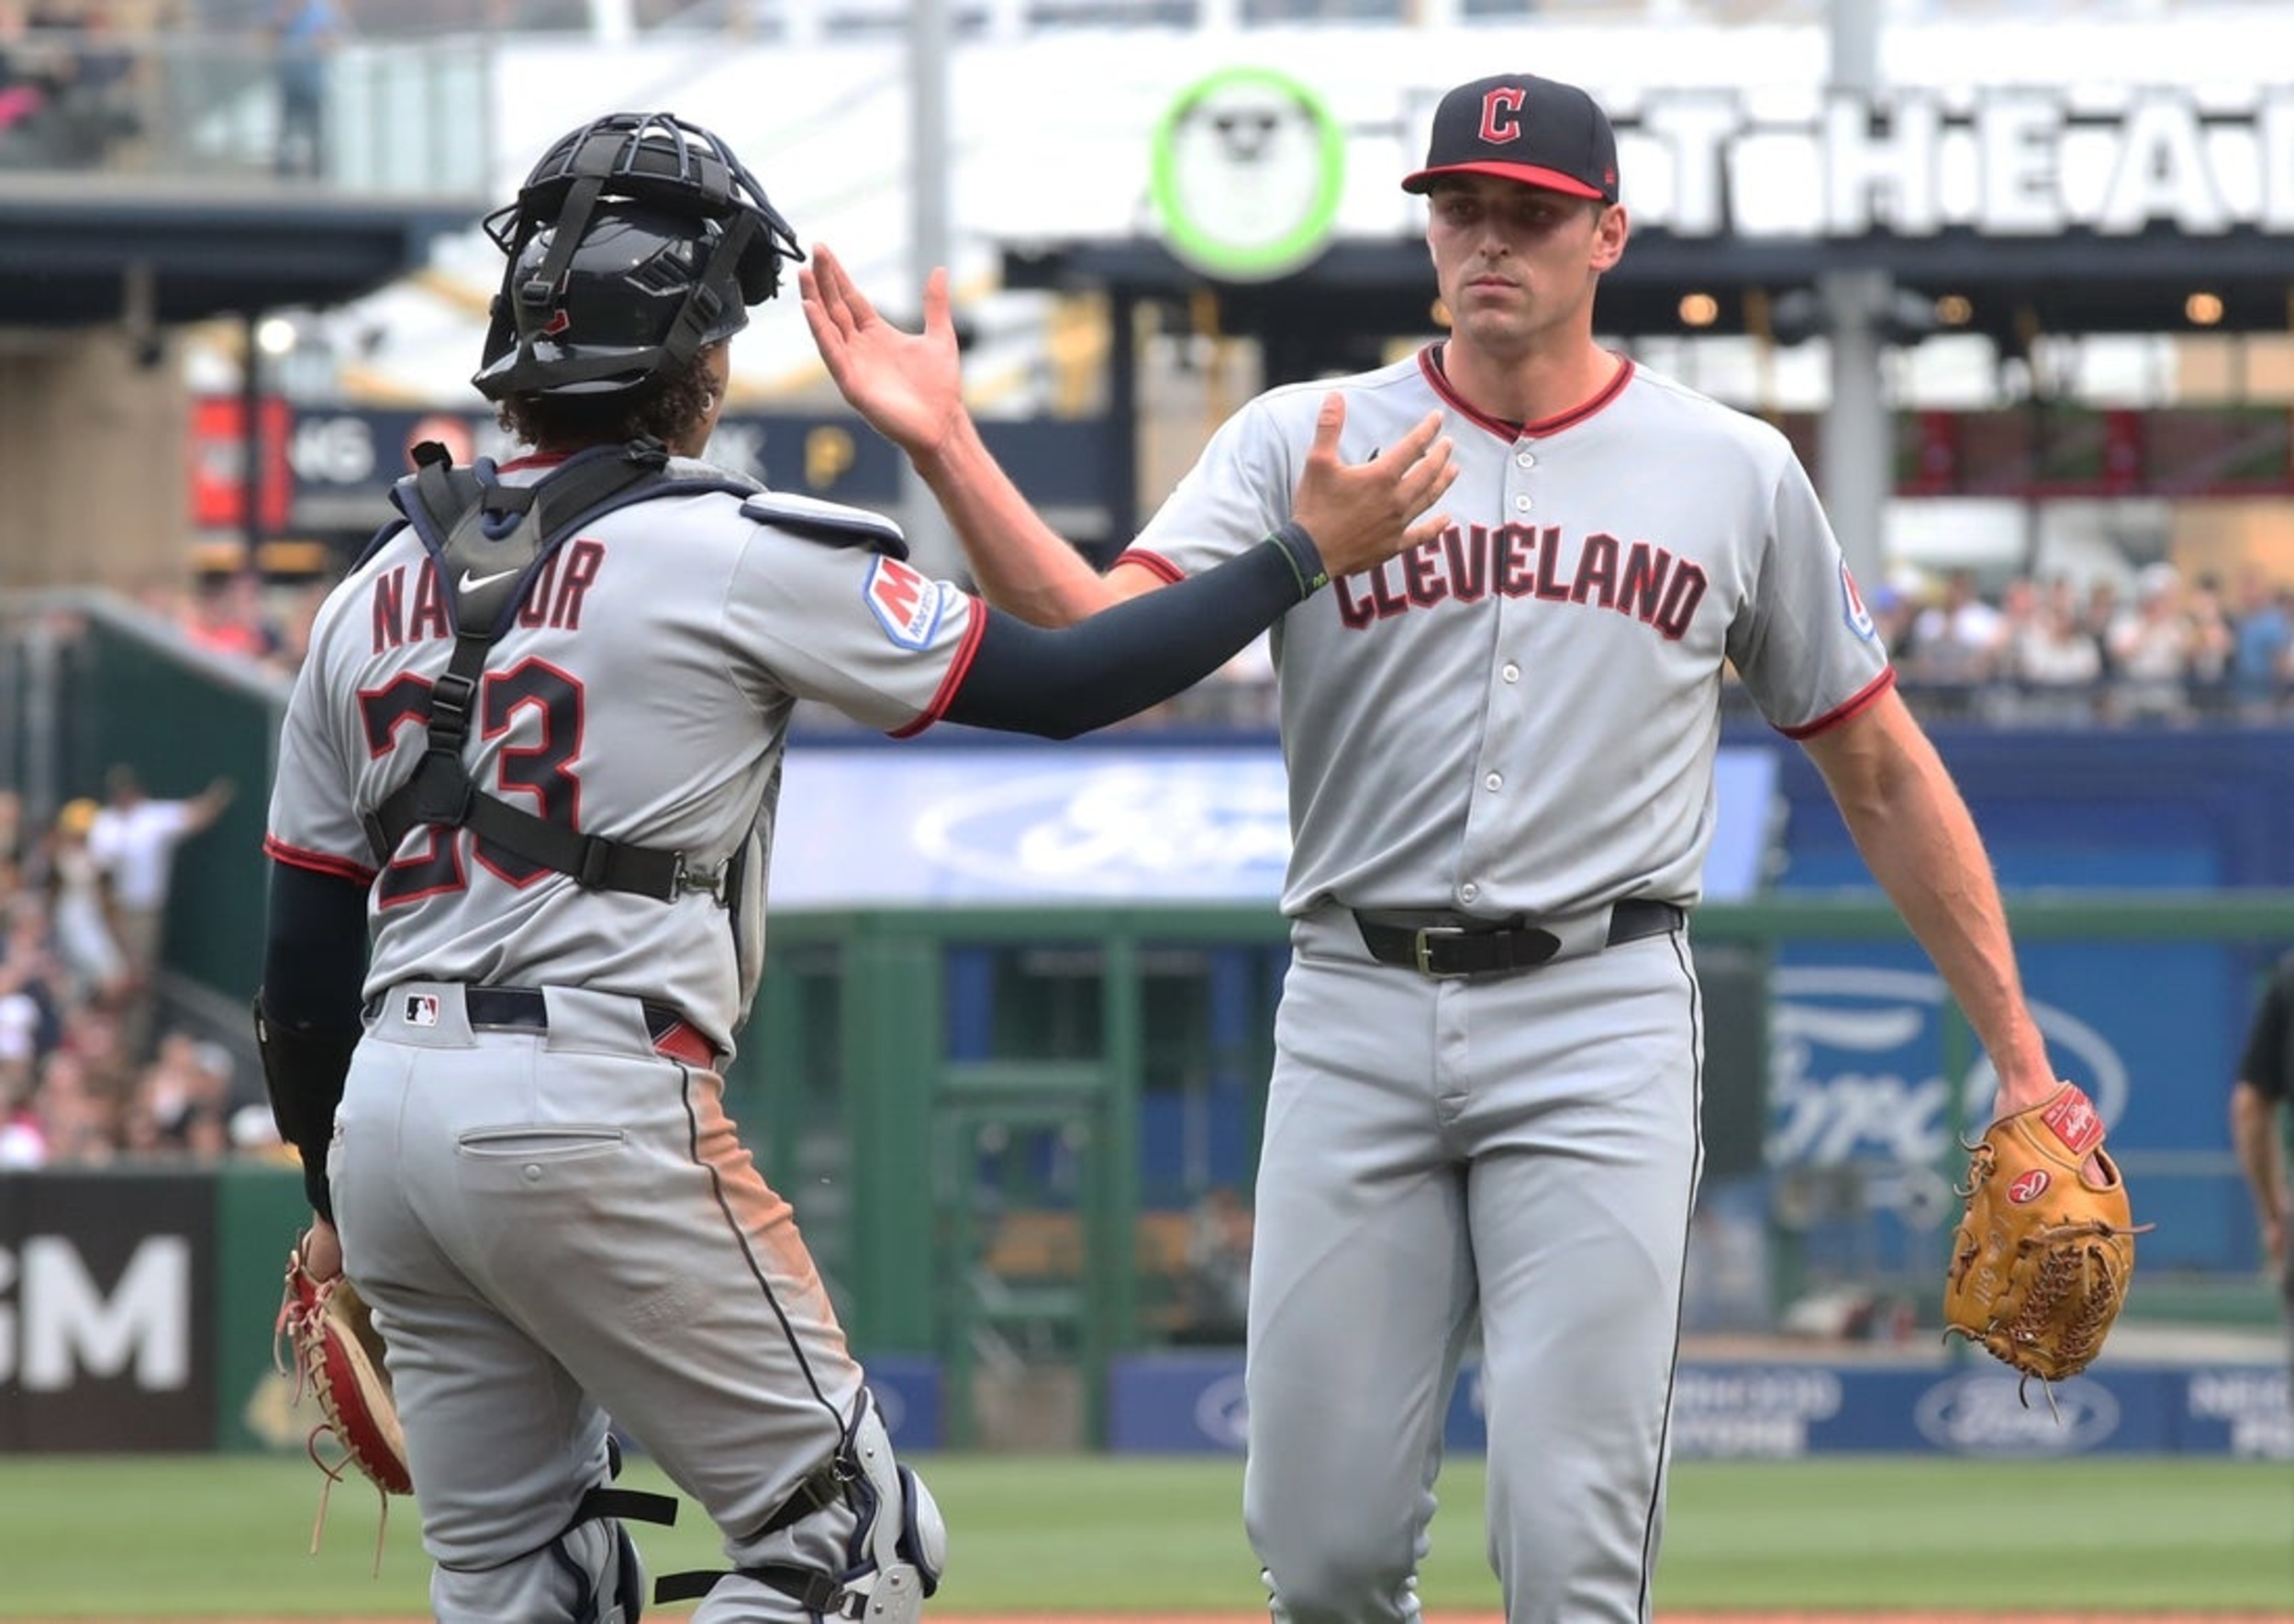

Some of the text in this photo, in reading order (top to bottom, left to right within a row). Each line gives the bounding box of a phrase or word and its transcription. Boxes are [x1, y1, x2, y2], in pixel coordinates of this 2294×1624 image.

[1478, 86, 1527, 144] C
[1333, 521, 1708, 641] CLEVELAND
[356, 655, 585, 909] 23
